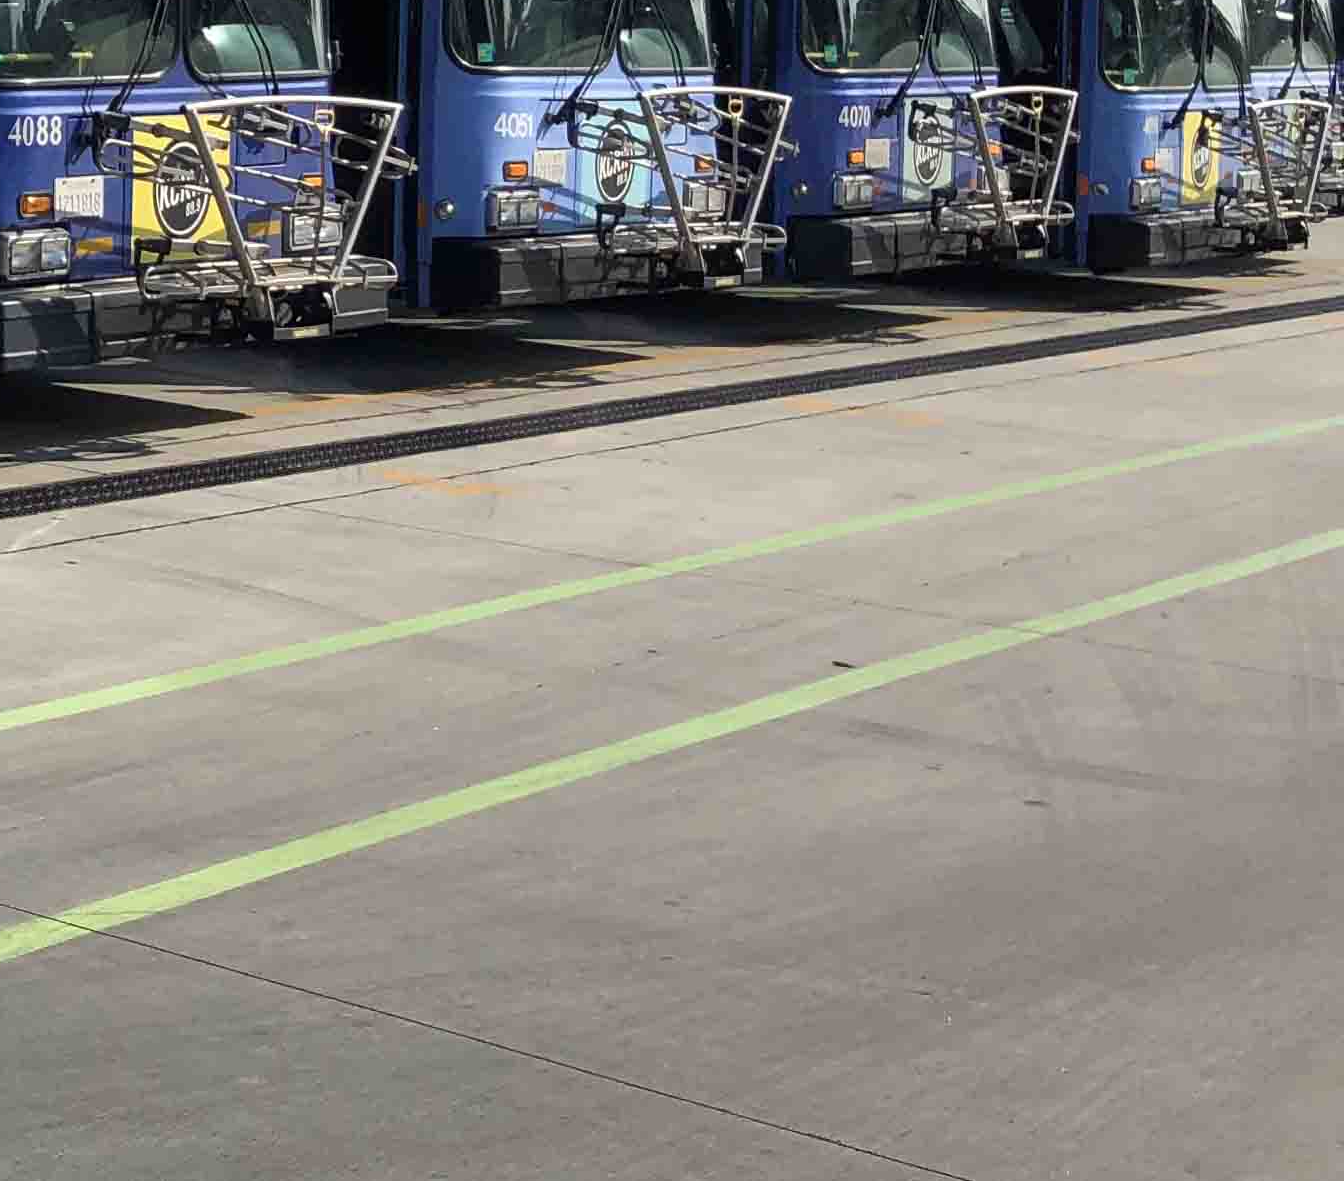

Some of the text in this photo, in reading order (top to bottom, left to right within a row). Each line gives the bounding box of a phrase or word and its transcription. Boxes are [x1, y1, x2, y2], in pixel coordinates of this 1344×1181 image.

[494, 113, 532, 137] 4051
[839, 105, 871, 127] 4070
[8, 115, 62, 146] 4088
